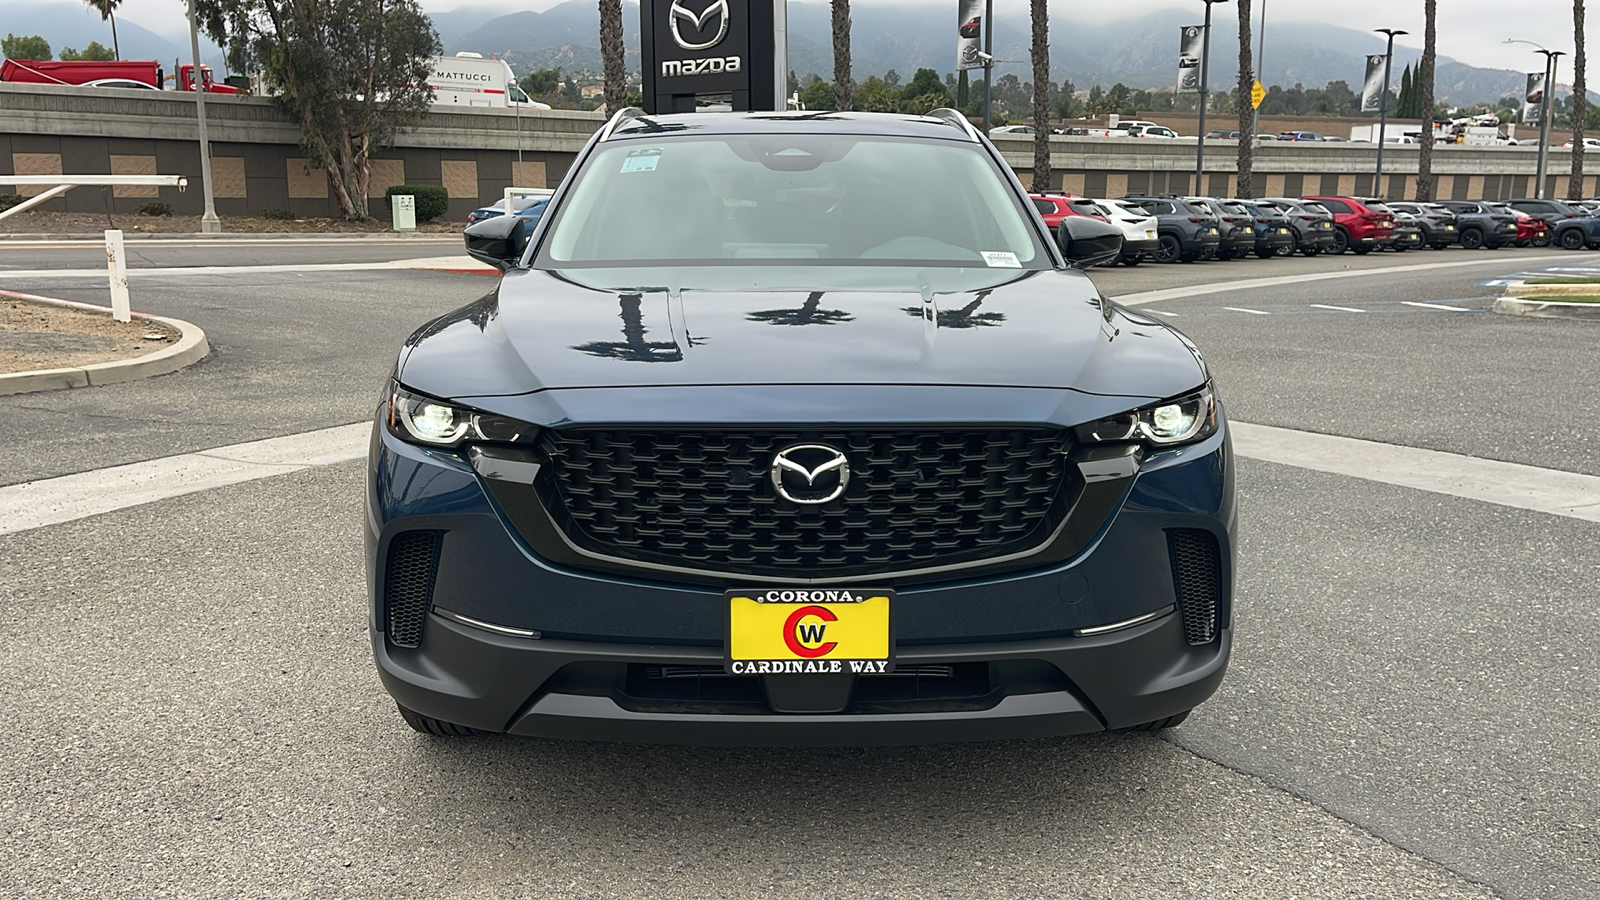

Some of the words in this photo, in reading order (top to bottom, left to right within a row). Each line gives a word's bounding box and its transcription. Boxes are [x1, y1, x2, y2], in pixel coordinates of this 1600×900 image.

[437, 71, 491, 82] MATTUCCI
[766, 590, 854, 602] CORONA
[732, 660, 842, 674] CARDINALE
[849, 660, 889, 673] WAY
